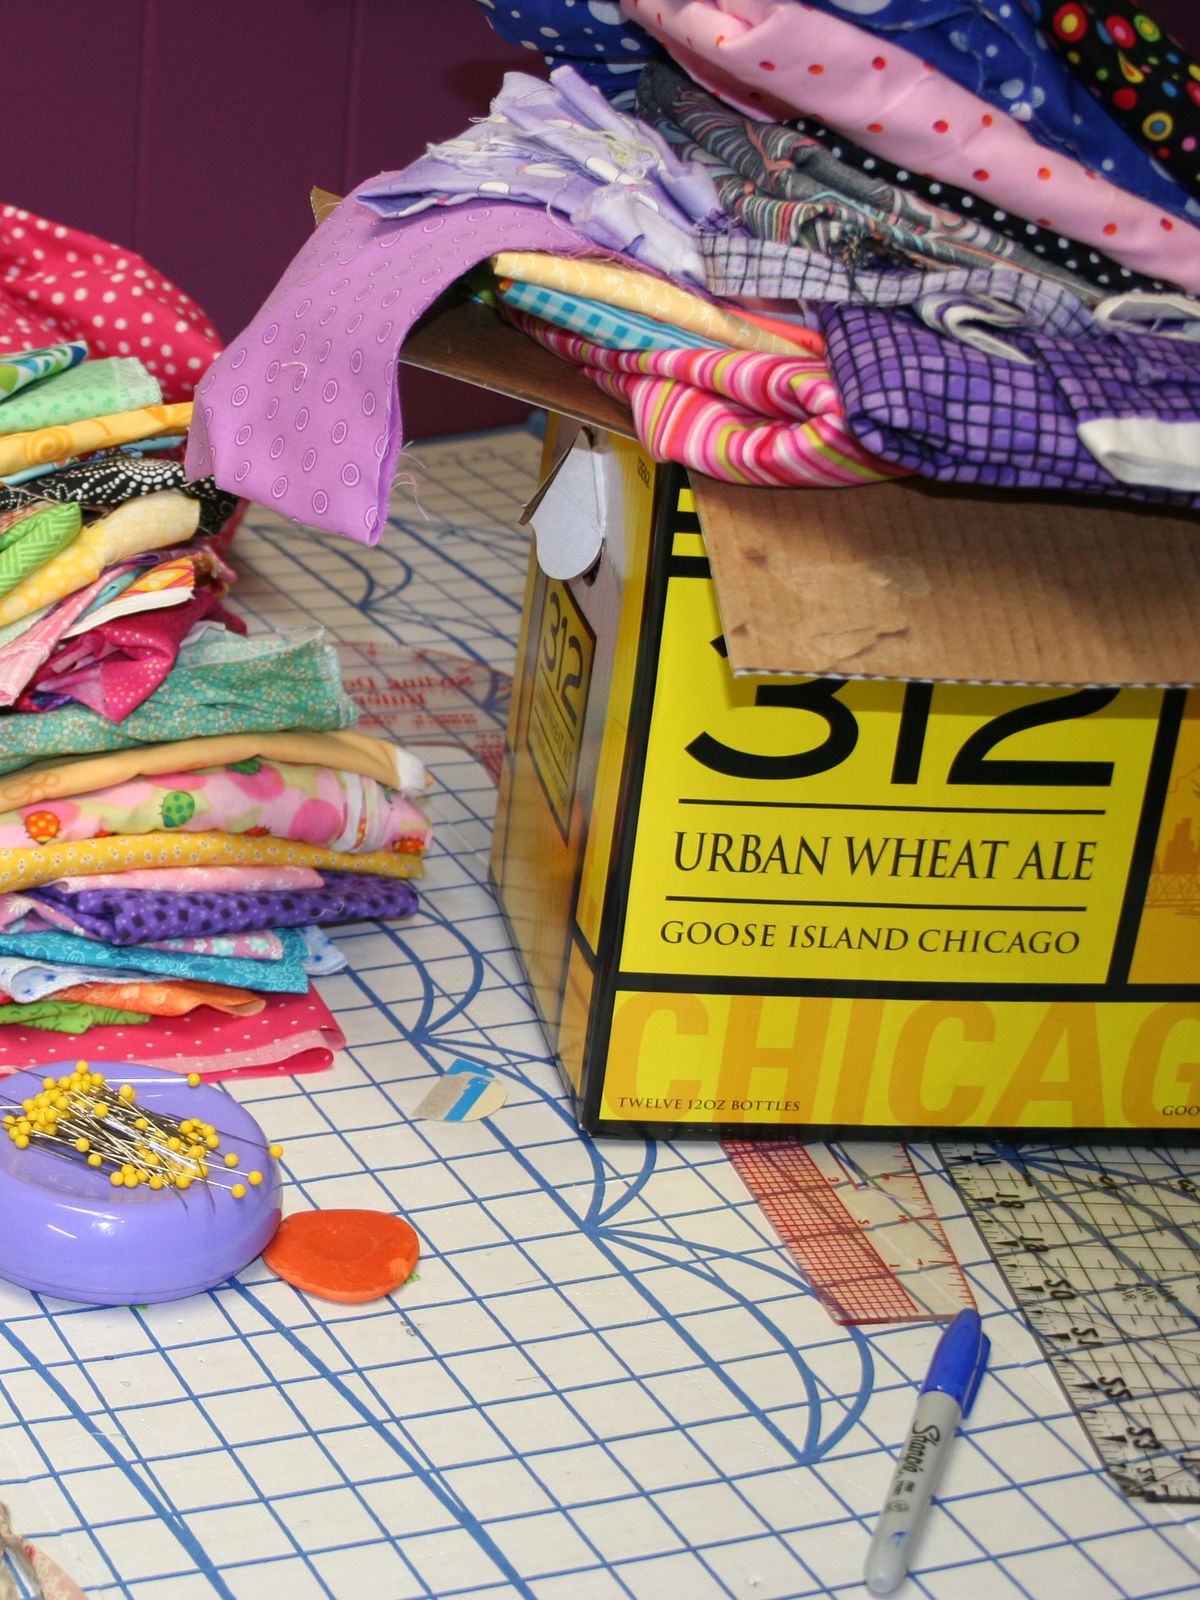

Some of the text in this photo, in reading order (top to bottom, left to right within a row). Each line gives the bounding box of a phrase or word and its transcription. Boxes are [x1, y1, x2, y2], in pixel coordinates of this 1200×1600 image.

[544, 592, 584, 727] 312
[673, 831, 1098, 881] URBAN WHEAT ALE
[660, 920, 1080, 955] GOOSE ISLAND CHICAGO
[617, 1096, 682, 1110] TWELVE
[732, 1099, 800, 1112] BOTTLES
